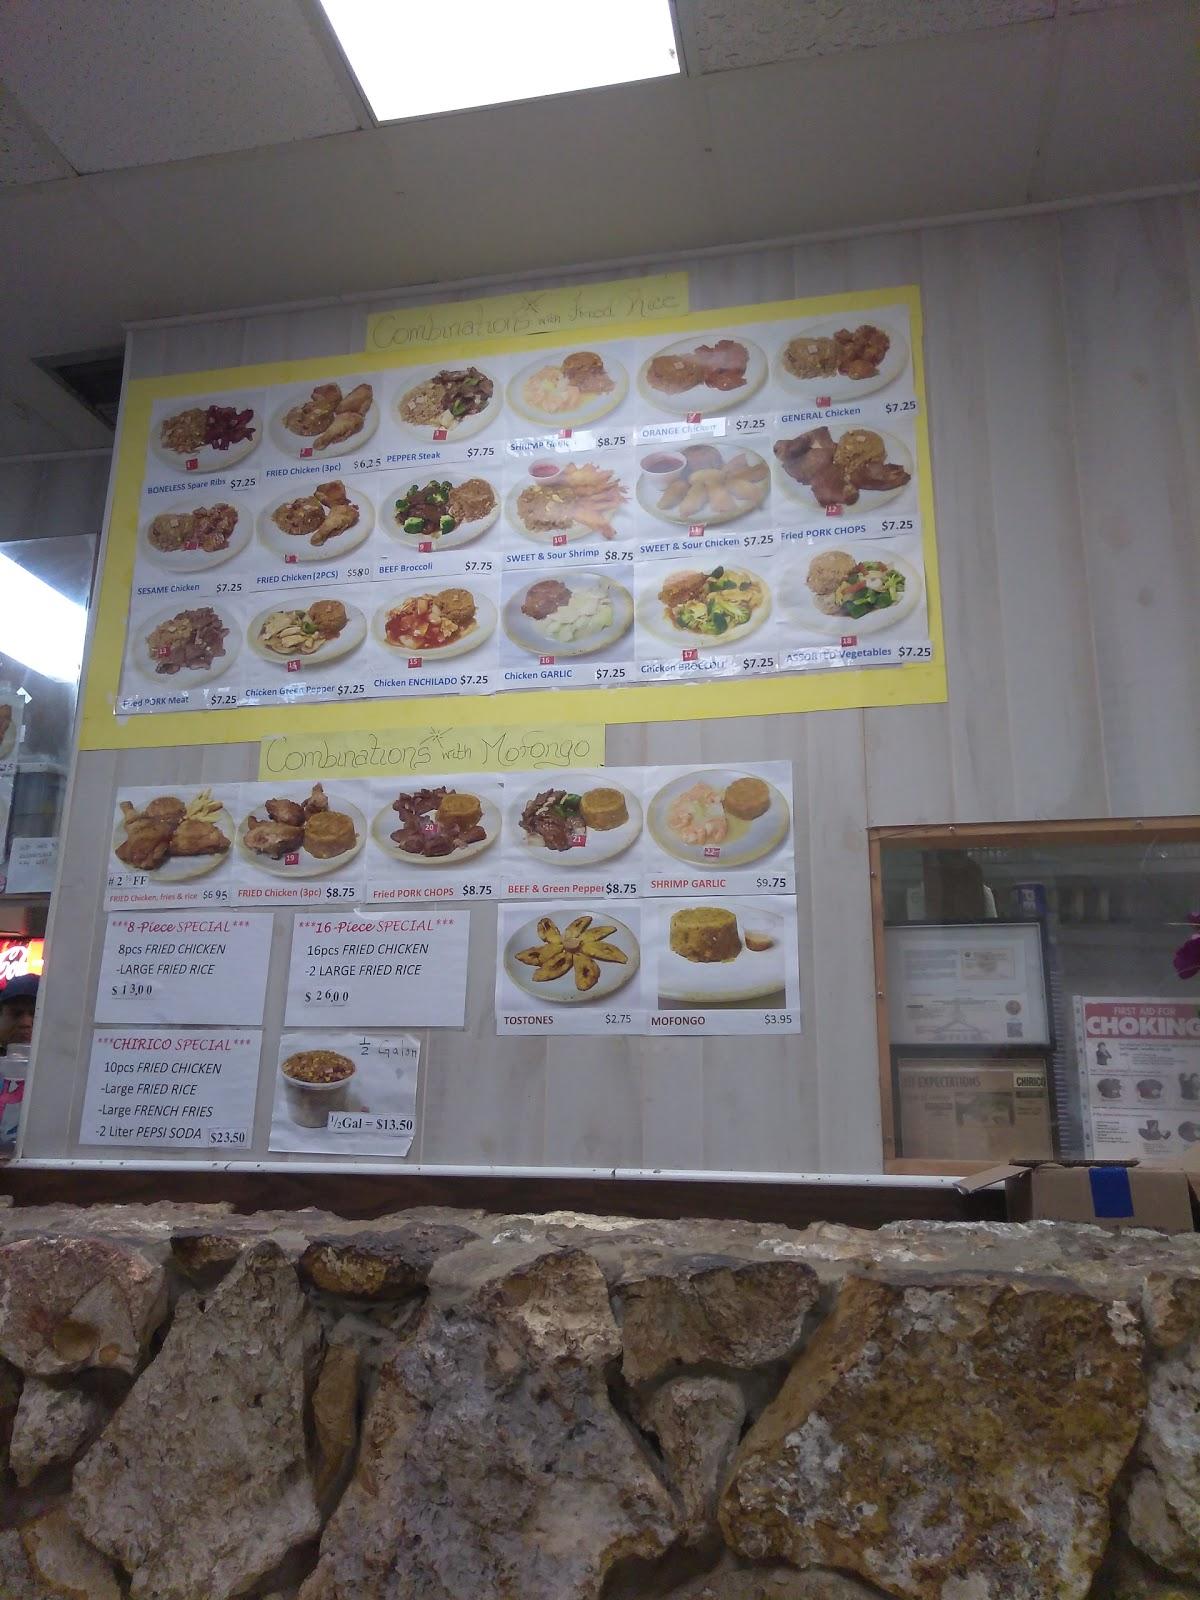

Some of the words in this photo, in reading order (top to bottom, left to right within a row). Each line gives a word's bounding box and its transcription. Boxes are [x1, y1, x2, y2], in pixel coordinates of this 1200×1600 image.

[781, 412, 823, 423] GENERAL
[825, 407, 861, 418] Chicken
[885, 400, 916, 413] $7.25
[642, 426, 679, 438] ORANGE
[736, 419, 766, 429] $7.25
[597, 436, 626, 446] $8.75
[386, 453, 417, 463] PEPPER
[419, 451, 440, 461] Steak
[467, 447, 494, 458] $7.75
[266, 468, 288, 478] FRIED
[290, 465, 320, 476] Chicken
[322, 462, 341, 473] (3pc)
[147, 483, 186, 494] BONELESS
[187, 480, 208, 491] Spare
[210, 478, 225, 487] Ribs
[230, 478, 256, 489] $7.25
[780, 531, 803, 541] Fried
[806, 527, 832, 538] PORK
[833, 524, 866, 535] CHOPS
[881, 520, 913, 532] $7.25
[640, 543, 671, 554] SWEET
[673, 542, 680, 550] &
[682, 540, 702, 549] Sour
[705, 538, 740, 548] Chicken
[743, 535, 774, 546] $7.25
[506, 554, 535, 563] SWEET
[538, 552, 545, 560] &
[546, 551, 567, 560] Sour
[569, 548, 599, 559] Shrimp
[605, 551, 634, 561] $8.75
[379, 565, 399, 574] BEEF
[401, 562, 433, 572] Broccoli
[464, 561, 492, 571] $7.75
[257, 575, 279, 584] FRIED
[281, 572, 312, 582] Chicken
[313, 570, 339, 581] (2PCS)
[137, 585, 169, 595] SESAME
[170, 583, 200, 593] Chicken
[216, 583, 242, 593] $7.25
[839, 647, 892, 660] Vegetables
[898, 646, 931, 658] $7.25
[640, 662, 676, 673] Chicken
[743, 657, 774, 671] $7.25
[504, 670, 538, 680] Chicken
[540, 669, 572, 679] GARLIC
[596, 668, 626, 679] $7.25
[374, 678, 406, 687] Chicken
[408, 677, 457, 686] ENCHILADO
[460, 675, 488, 685] $7.25
[245, 688, 277, 697] Chicken
[306, 684, 335, 695] Pepper
[337, 684, 365, 695] $7.25
[123, 699, 143, 707] Fed
[168, 695, 189, 704] Meat
[211, 695, 237, 705] $7.25
[266, 733, 432, 773] Combinations
[132, 875, 147, 886] FF
[651, 880, 689, 889] SHRIMP
[691, 879, 726, 888] GARLIC
[756, 878, 786, 888] $9.75
[238, 889, 262, 898] FRIED
[264, 888, 298, 897] Chicken
[300, 888, 322, 898] (3pc)
[326, 887, 355, 898] $8.75
[373, 889, 395, 898] Fried
[397, 888, 422, 897] PORK
[424, 887, 454, 897] CHOPS
[462, 885, 492, 896] $8.75
[508, 884, 529, 894] BEEF
[532, 885, 539, 894] &
[542, 884, 570, 894] Green
[572, 884, 604, 895] Pepper
[606, 883, 637, 895] $8.75
[110, 893, 129, 902] FRIED
[160, 893, 174, 901] fries
[118, 944, 142, 956] 8pcs
[145, 944, 175, 954] FRIED
[178, 944, 226, 955] CHICKEN
[307, 945, 339, 957] 16pcs
[342, 944, 375, 955] FRIED
[378, 944, 429, 955] CHICKEN
[116, 964, 154, 975] -LARGE
[157, 965, 187, 975] FRIED
[190, 964, 215, 974] RICE
[319, 965, 356, 976] LARGE
[359, 965, 392, 975] FRIED
[395, 965, 422, 975] RICE
[1113, 1007, 1137, 1016] FIRST
[1159, 1008, 1176, 1016] FOR
[504, 1015, 554, 1025] TOSTONES
[605, 1014, 632, 1025] $2.75
[651, 1016, 706, 1026] MOFONGO
[764, 1014, 792, 1024] $3.95
[1087, 1016, 1200, 1036] CHOKING
[104, 1062, 134, 1075] 10pcs
[137, 1062, 168, 1073] FRIED
[171, 1063, 222, 1074] CHICKEN
[136, 1084, 168, 1095] FRIED
[171, 1084, 198, 1095] RICE
[134, 1105, 178, 1116] FRENCH
[182, 1106, 213, 1117] FRIES
[376, 1119, 413, 1131] $13.50
[109, 1126, 136, 1137] Liter
[136, 1127, 166, 1138] PEPSI
[169, 1128, 201, 1139] SODA
[210, 1132, 245, 1143] $23.50
